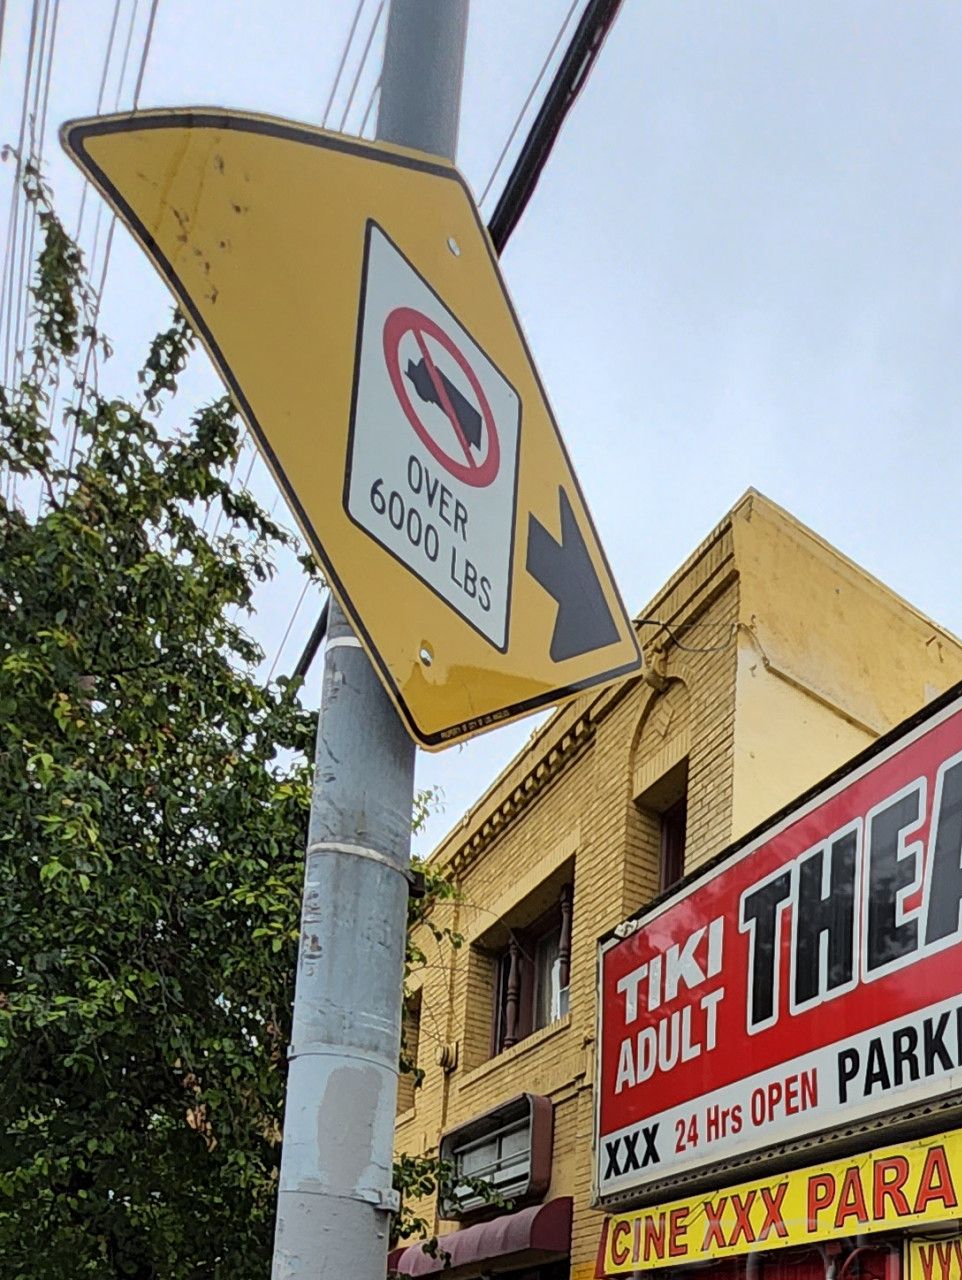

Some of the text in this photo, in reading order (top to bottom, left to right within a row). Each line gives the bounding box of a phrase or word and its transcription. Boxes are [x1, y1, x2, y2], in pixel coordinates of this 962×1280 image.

[370, 477, 492, 613] 6000 LBS
[407, 454, 469, 542] OVER
[616, 915, 724, 1025] TIKI
[613, 986, 725, 1095] ADULT
[603, 1122, 661, 1181] XXX
[674, 1117, 699, 1154] 24
[706, 1103, 743, 1143] Hrs
[750, 1067, 819, 1127] OPEN
[610, 1205, 690, 1266] CINE
[699, 1181, 789, 1252] XXX
[806, 1145, 958, 1234] PARA
